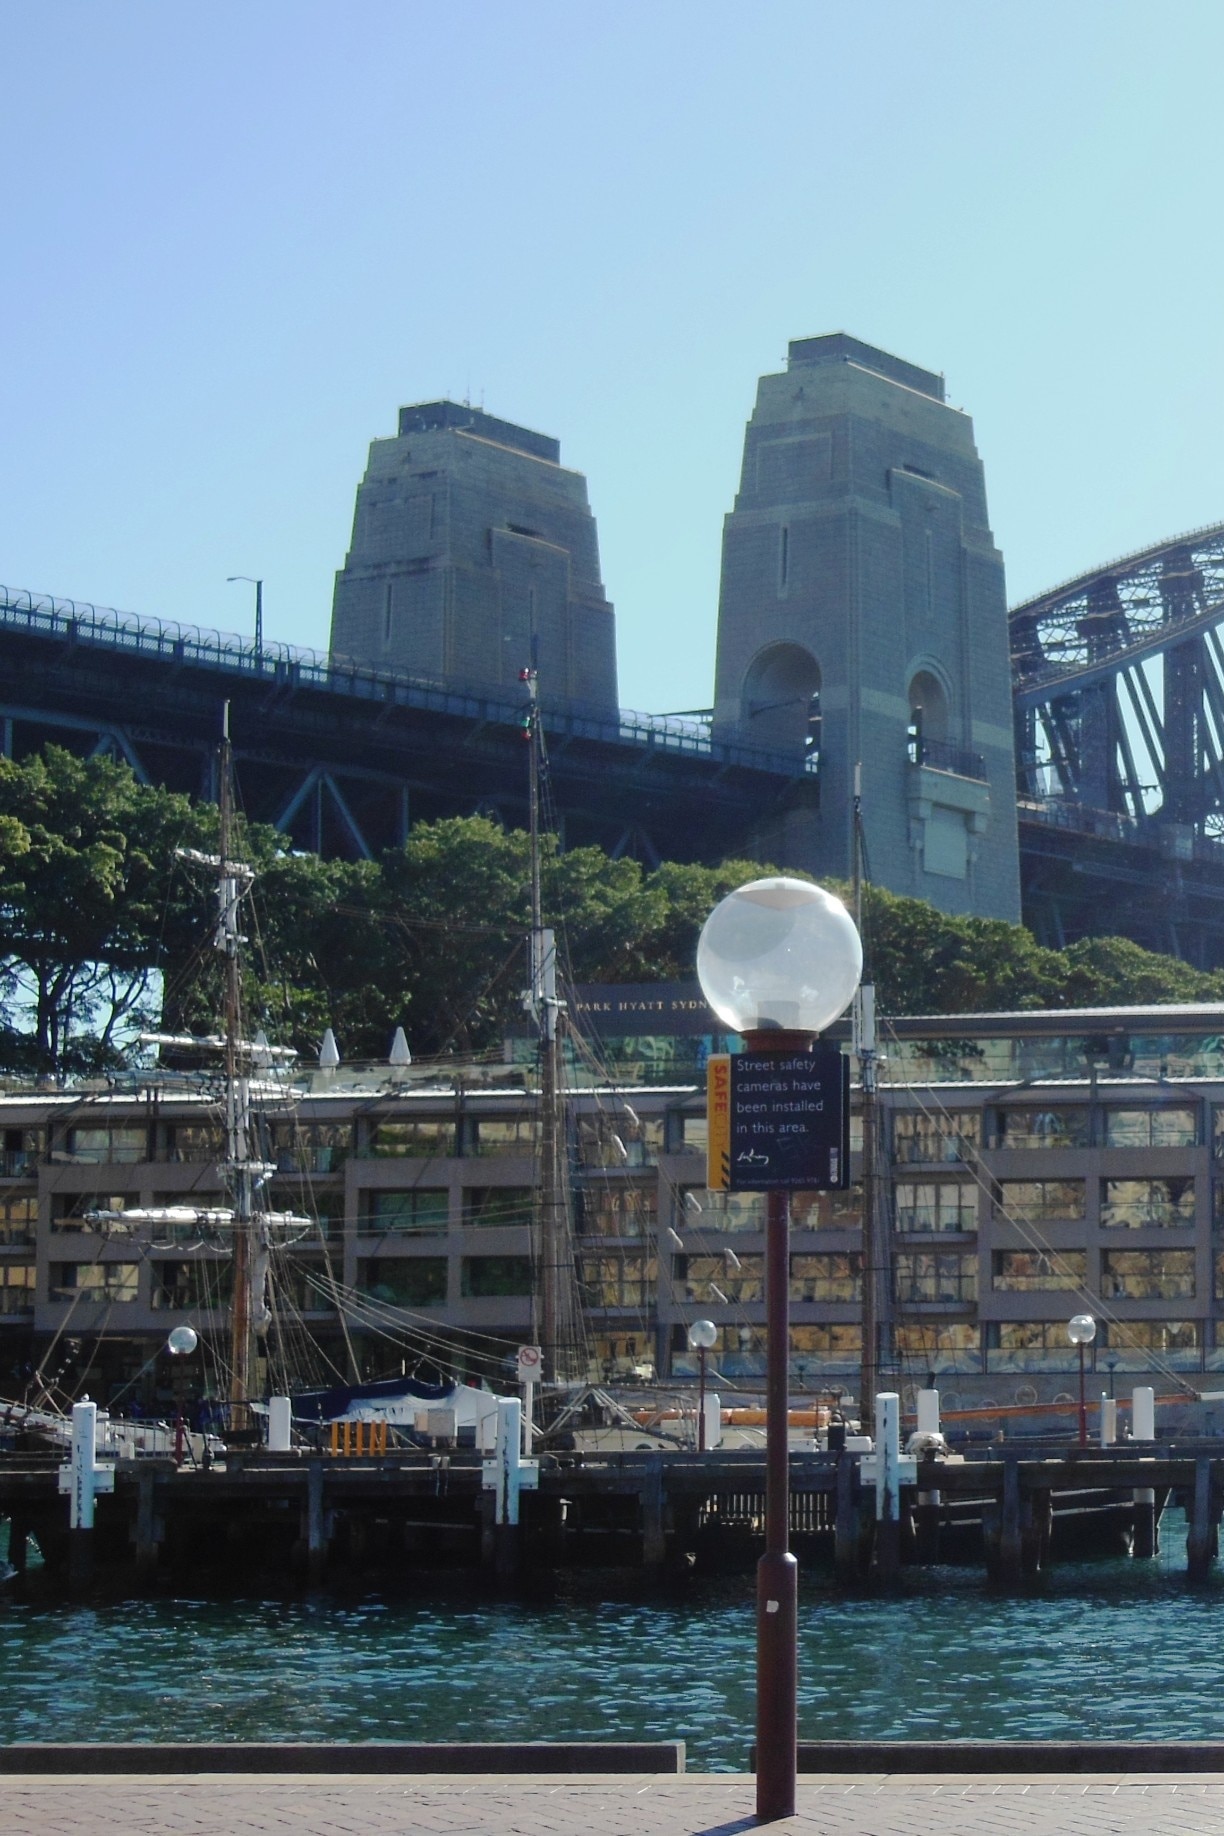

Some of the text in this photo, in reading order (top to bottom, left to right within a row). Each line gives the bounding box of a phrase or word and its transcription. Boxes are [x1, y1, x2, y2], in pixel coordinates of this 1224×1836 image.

[577, 1000, 708, 1011] PARK HYATT SYDN
[737, 1058, 816, 1072] Street safety
[736, 1080, 822, 1092] cameras have
[736, 1100, 824, 1113] been installed
[736, 1122, 810, 1133] in this area.
